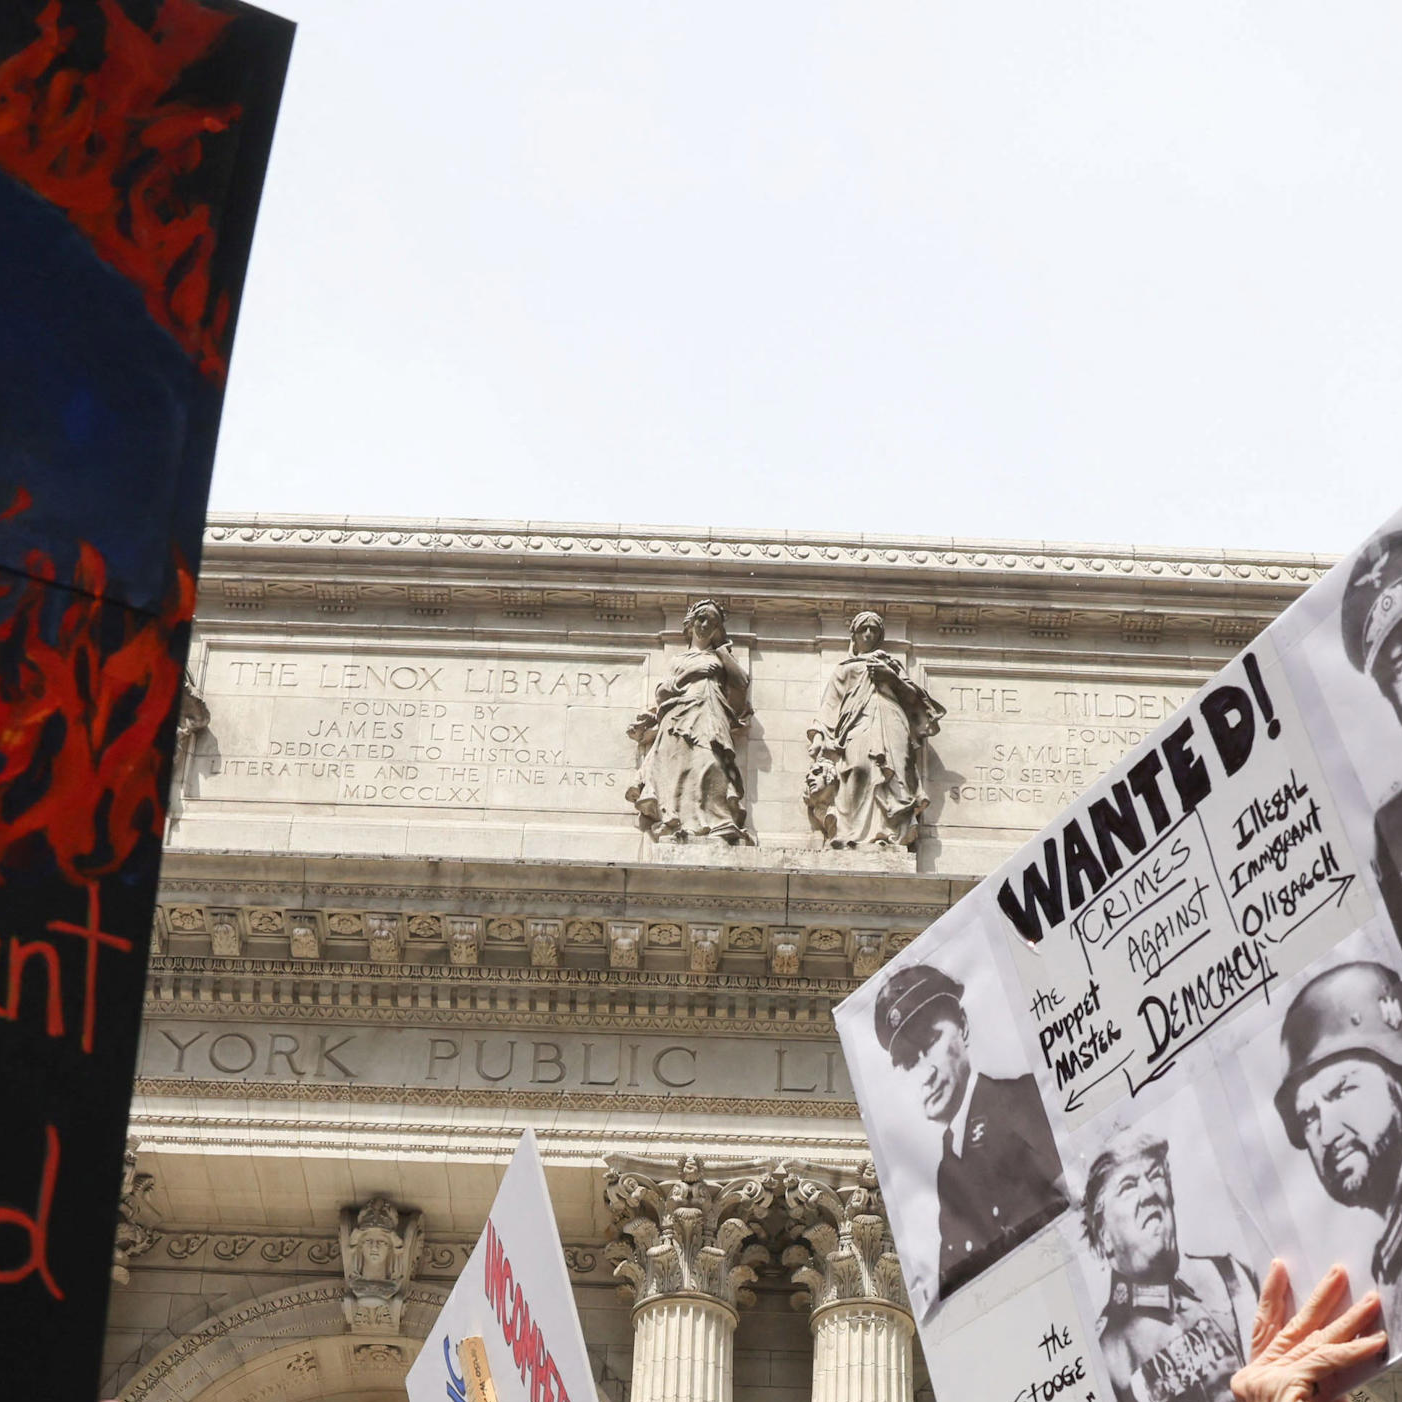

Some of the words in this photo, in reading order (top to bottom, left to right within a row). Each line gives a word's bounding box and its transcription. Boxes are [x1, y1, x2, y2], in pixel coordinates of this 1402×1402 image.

[230, 661, 298, 688] THE
[320, 663, 444, 692] LENOX
[465, 667, 621, 698] LIBRARY
[340, 700, 447, 718] FOUNDED
[474, 705, 500, 720] BY
[950, 687, 1021, 713] THE
[307, 720, 404, 740] JAMES
[430, 723, 529, 743] LENOX
[1067, 728, 1150, 745] FOUND
[269, 741, 394, 760] DEDICATED
[410, 745, 441, 761] TO
[993, 744, 1098, 766] SAMUEL
[211, 760, 355, 779] LITERATURE
[374, 764, 418, 781] AND
[437, 766, 480, 783] THE
[496, 768, 545, 785] FINE
[558, 770, 616, 788] ARTS
[974, 766, 1007, 782] TO
[1020, 769, 1084, 785] SERVE
[344, 785, 481, 802] MDCCCLXX
[949, 786, 1044, 804] SCIENCE
[997, 652, 1282, 945] WANTED!
[1082, 838, 1190, 943] CRIMES
[159, 1028, 358, 1079] YORK
[424, 1036, 697, 1089] PUBLIC
[775, 1047, 841, 1096] LI
